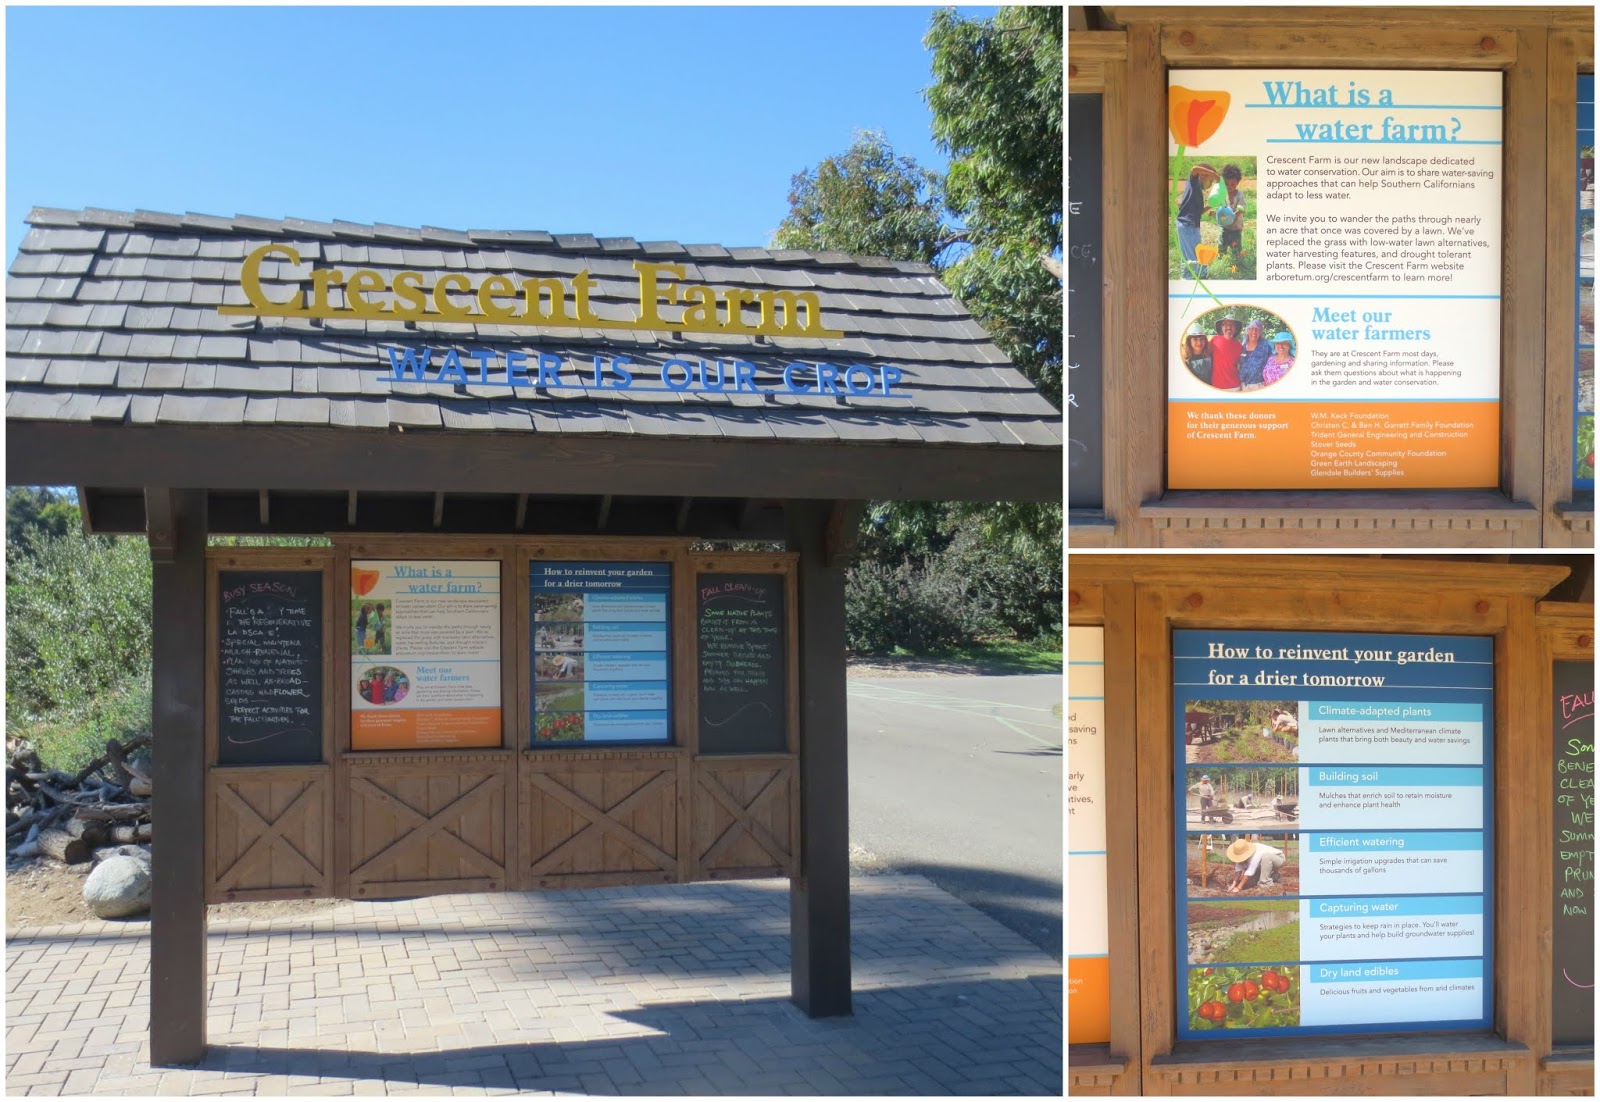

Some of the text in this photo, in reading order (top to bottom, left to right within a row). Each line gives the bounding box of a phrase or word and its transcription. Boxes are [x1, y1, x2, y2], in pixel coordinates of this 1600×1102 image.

[1263, 81, 1394, 105] What is a
[1295, 117, 1462, 142] water farm?
[1266, 155, 1306, 164] Crescent
[1308, 155, 1332, 164] Farm
[1334, 156, 1342, 164] is
[1382, 156, 1428, 167] landscape
[1429, 156, 1475, 166] dedicated
[1266, 179, 1319, 190] approaches
[1320, 179, 1338, 188] that
[1358, 179, 1379, 190] help
[1381, 179, 1421, 188] Southern
[1423, 179, 1475, 189] Californians
[1266, 190, 1351, 202] adapt to less water.
[1265, 214, 1281, 223] We
[1283, 214, 1308, 223] invite
[1309, 216, 1326, 225] you
[1339, 214, 1373, 223] wander
[1374, 214, 1390, 223] the
[1391, 214, 1416, 226] paths
[1418, 214, 1453, 226] through
[1455, 215, 1482, 226] nearly
[1266, 237, 1490, 249] replaced the grass with low-water lawn alternatives,
[1293, 249, 1339, 260] harvesting
[1340, 249, 1379, 259] features,
[1381, 249, 1398, 258] and
[1400, 250, 1436, 261] drought
[1437, 250, 1472, 259] tolerant
[1266, 272, 1453, 284] arboretum.org/crescentfarm to learn more!
[241, 244, 825, 332] Crescent Farm
[1312, 307, 1392, 324] Meet our
[1312, 325, 1431, 341] water farmers
[1311, 350, 1328, 359] They
[1420, 350, 1439, 359] days,
[387, 347, 903, 395] WATER IS OUR CROP
[1221, 423, 1257, 431] generous
[1258, 423, 1288, 431] support
[1186, 431, 1258, 439] of Crescent Farm.
[1310, 440, 1333, 448] Stover
[1310, 450, 1338, 459] Orange
[1338, 450, 1365, 458] County
[1365, 450, 1406, 458] Community
[1334, 459, 1353, 467] Earth
[1354, 460, 1398, 468] Landscaping
[394, 565, 452, 577] What is a
[544, 568, 562, 576] How
[575, 568, 606, 576] reinvent
[627, 569, 653, 577] garden
[408, 581, 482, 593] water farm?
[1208, 643, 1455, 665] How to reinvent your garden
[416, 666, 437, 674] Meet
[1208, 670, 1386, 687] for a drier tomorrow
[1318, 706, 1432, 718] Climate-adapted plants
[1337, 726, 1375, 734] alternatives
[1438, 727, 1462, 735] climate
[1319, 771, 1378, 784] Building soil
[1571, 812, 1594, 825] WE
[1319, 836, 1404, 849] Efficient watering
[1319, 858, 1342, 867] Simple
[1343, 858, 1373, 866] irrigation
[1374, 857, 1405, 866] upgrades
[1560, 888, 1584, 898] AND
[1319, 902, 1398, 913] Capturing water
[1563, 904, 1587, 916] NOW
[1320, 966, 1399, 979] Dry land edibles
